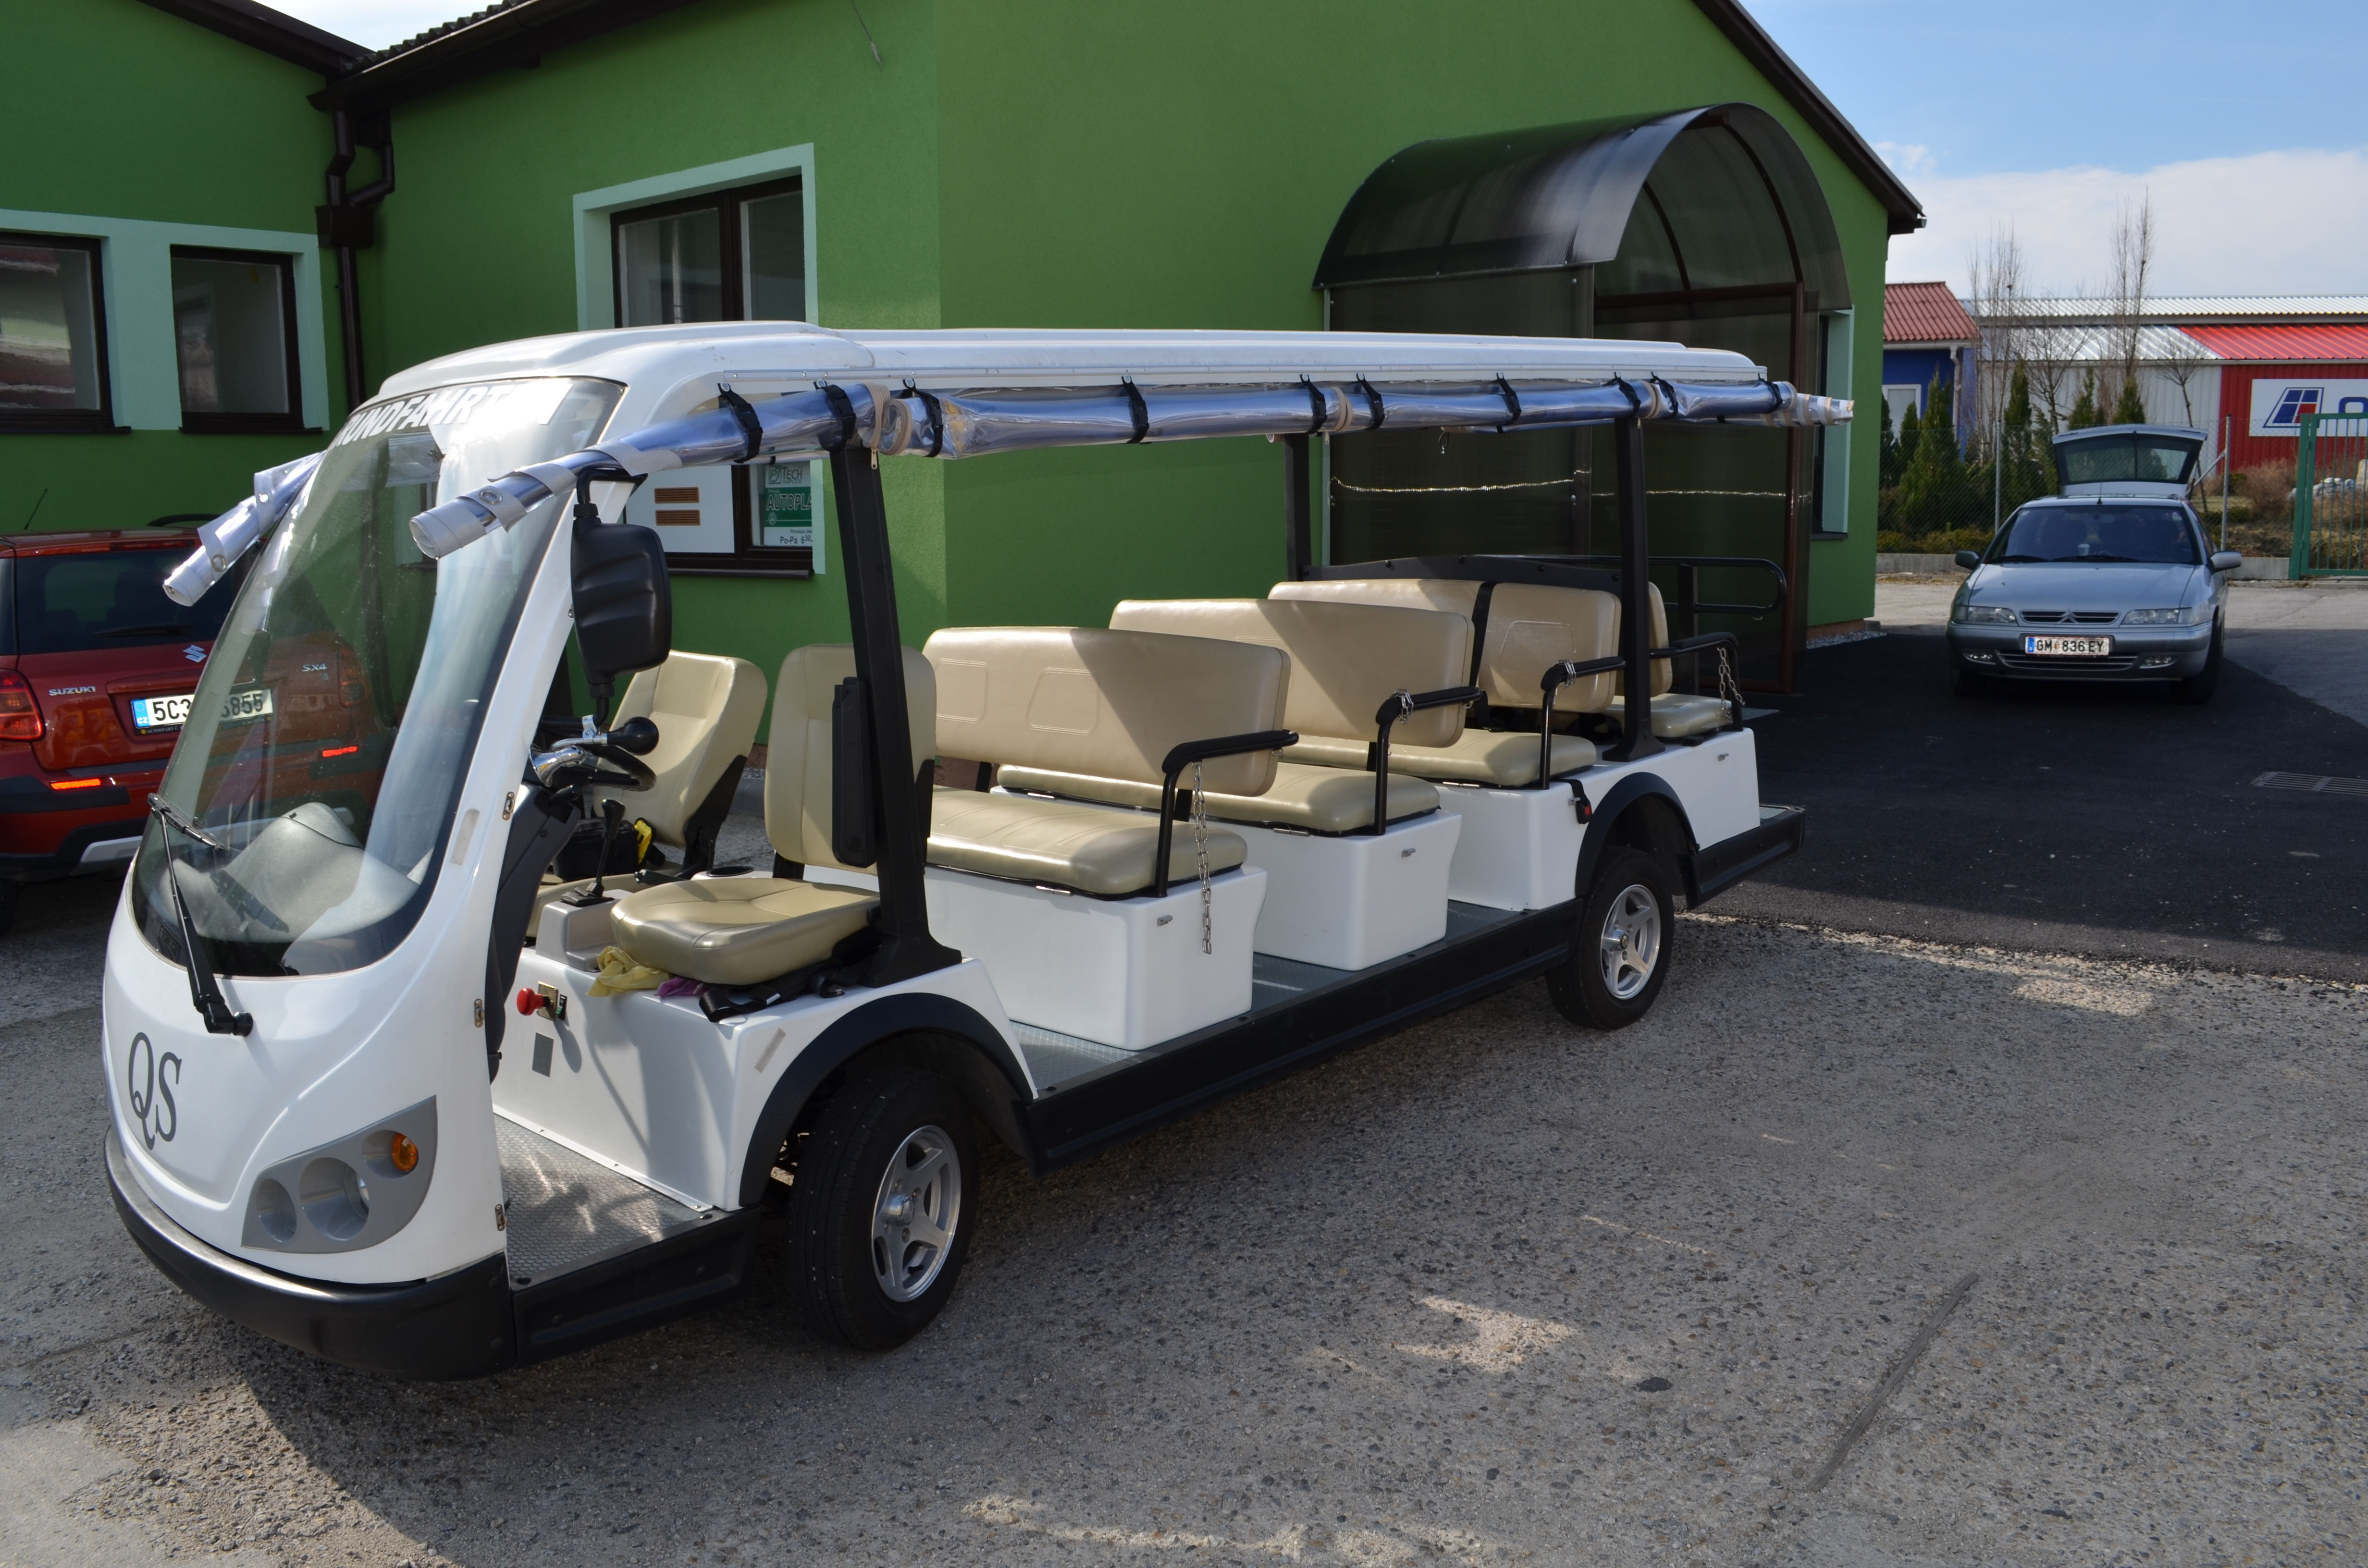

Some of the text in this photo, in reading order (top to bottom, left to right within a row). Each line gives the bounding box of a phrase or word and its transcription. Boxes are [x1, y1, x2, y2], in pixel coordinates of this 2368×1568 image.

[781, 466, 802, 479] TECH
[2036, 640, 2104, 652] GM 836 EY
[301, 663, 327, 672] SX4
[49, 686, 96, 696] SUZUKI
[128, 1031, 182, 1151] QS
